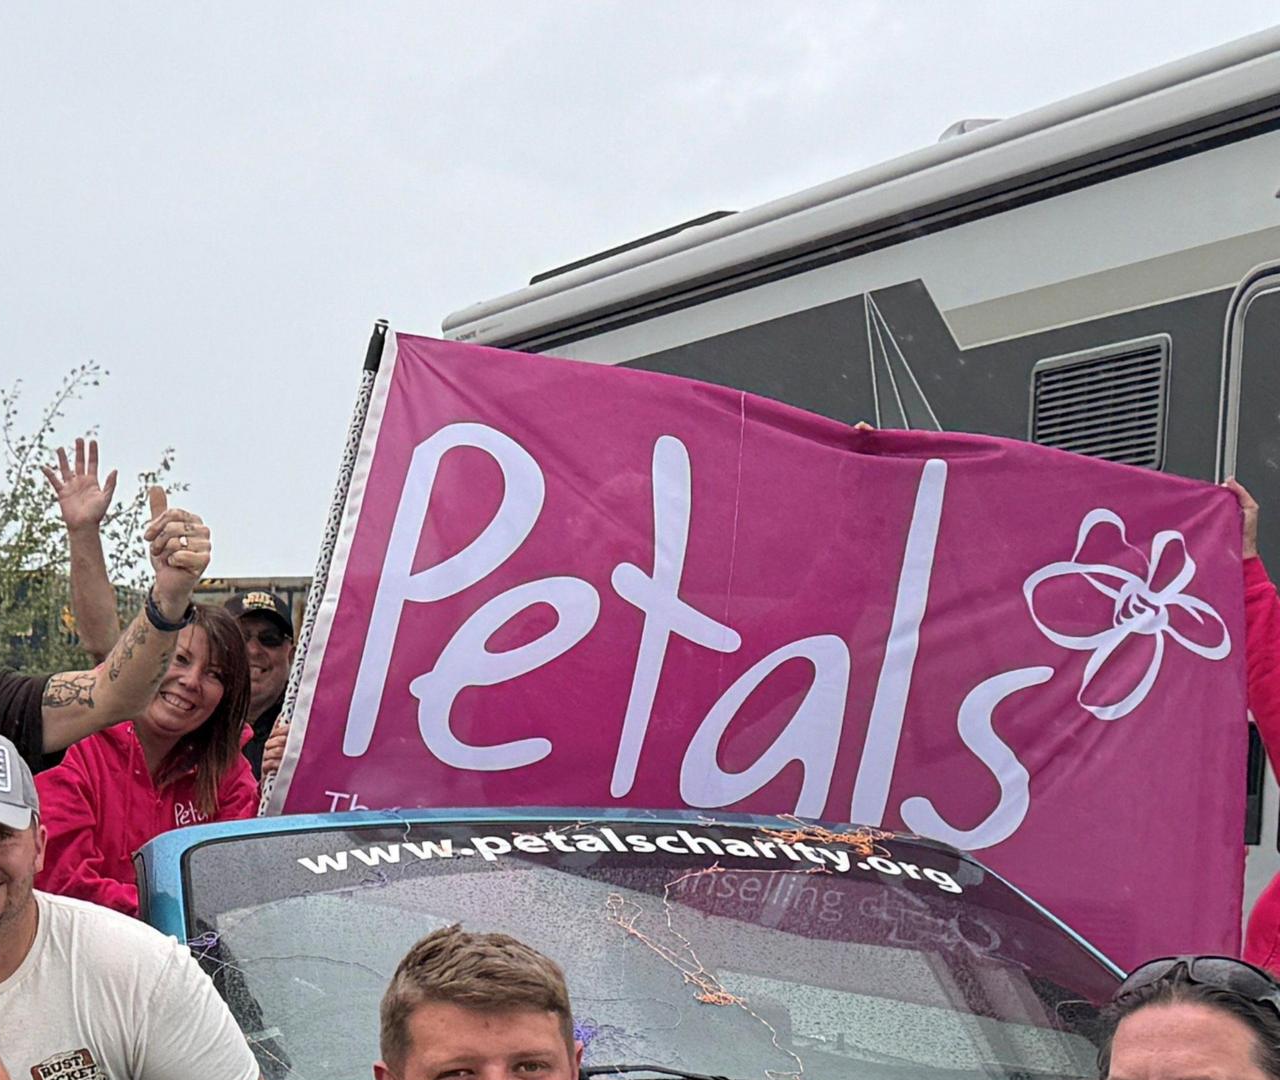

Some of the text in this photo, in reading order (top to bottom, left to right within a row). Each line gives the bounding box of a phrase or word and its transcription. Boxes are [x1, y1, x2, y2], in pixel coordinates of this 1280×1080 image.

[340, 421, 1053, 852] Petals
[297, 828, 964, 894] www.petalscharity.org
[40, 1056, 82, 1078] RUST
